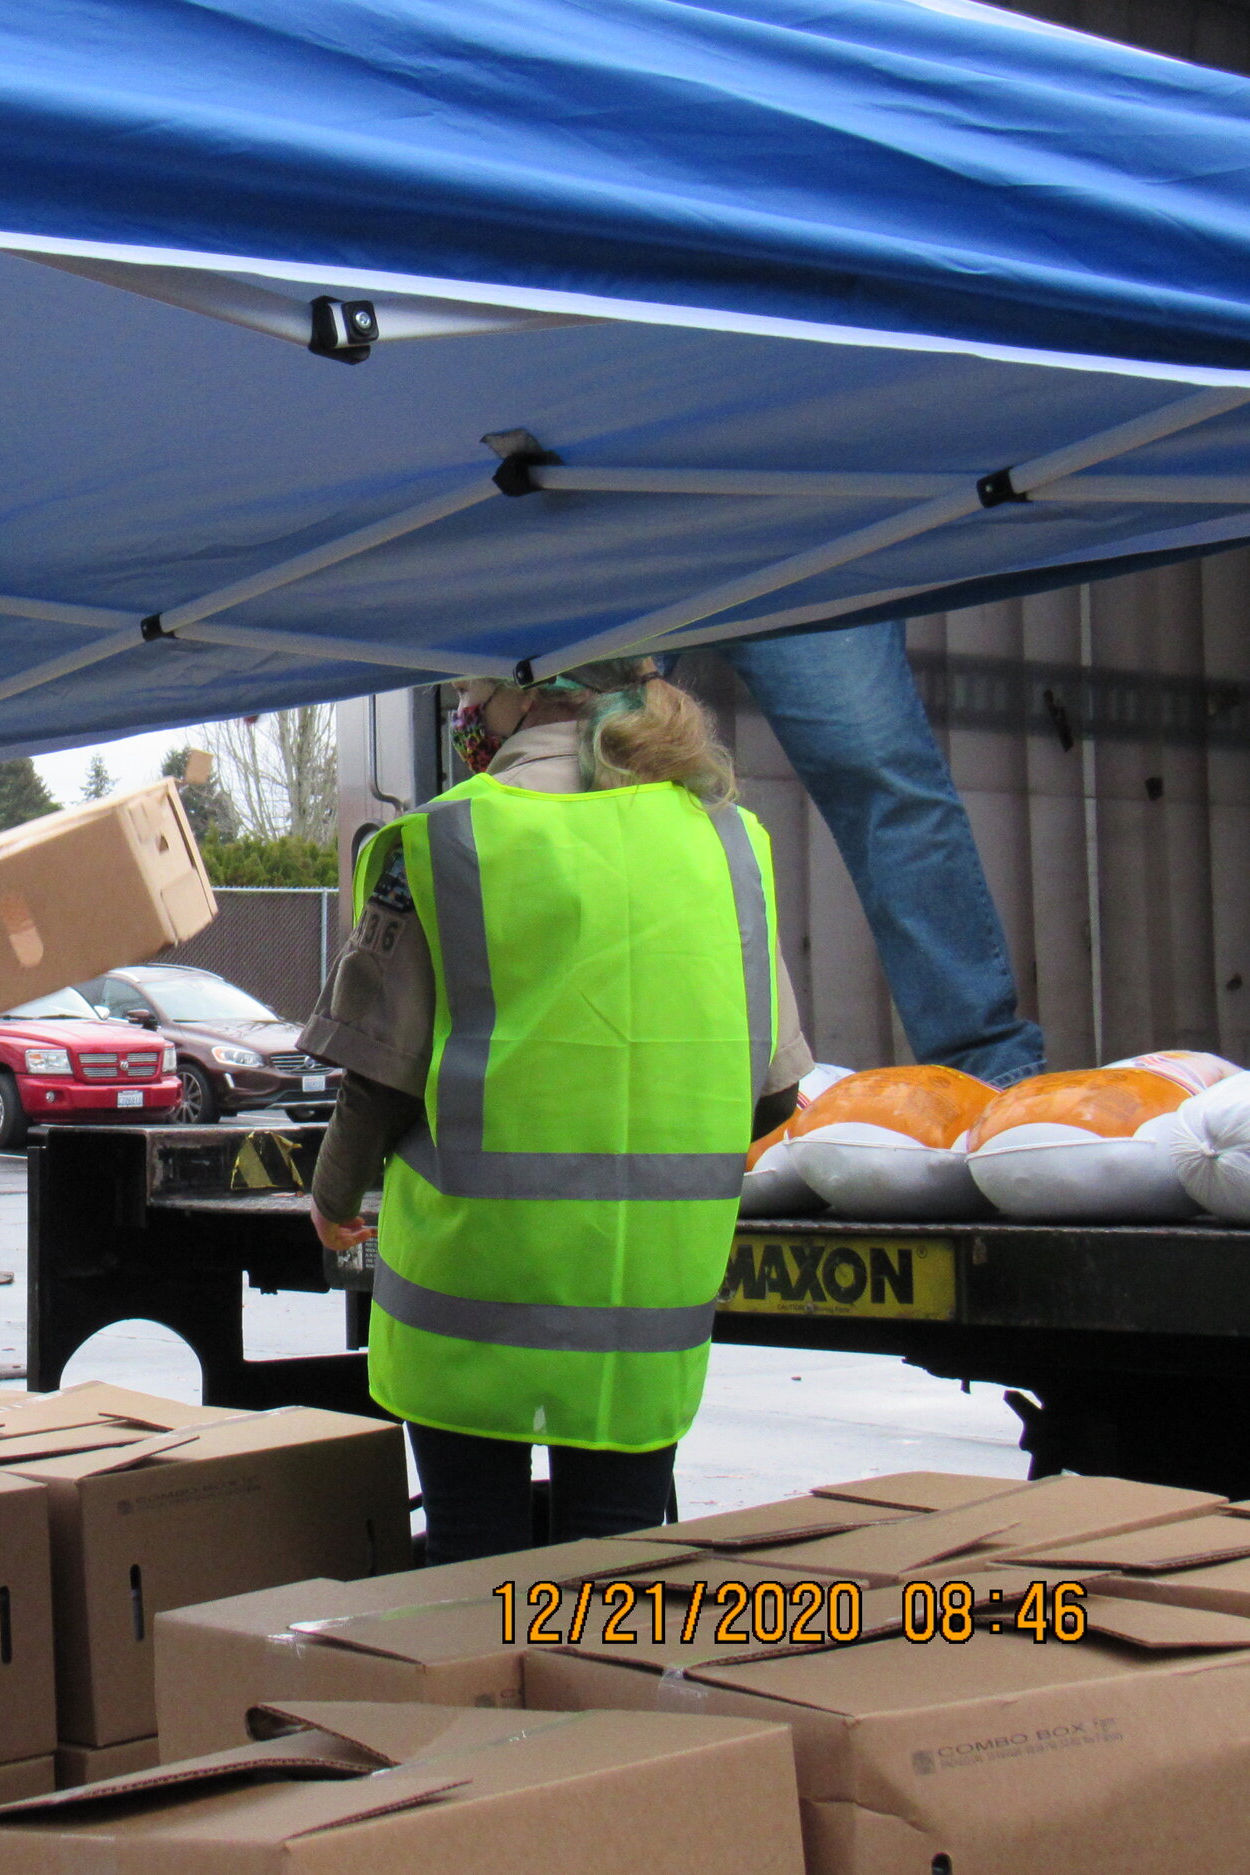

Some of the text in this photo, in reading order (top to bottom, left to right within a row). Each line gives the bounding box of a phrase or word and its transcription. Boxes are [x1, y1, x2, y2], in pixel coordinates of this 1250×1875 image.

[716, 1244, 913, 1304] MAXON
[937, 1732, 1029, 1758] COMBO
[1035, 1721, 1087, 1741] BOX
